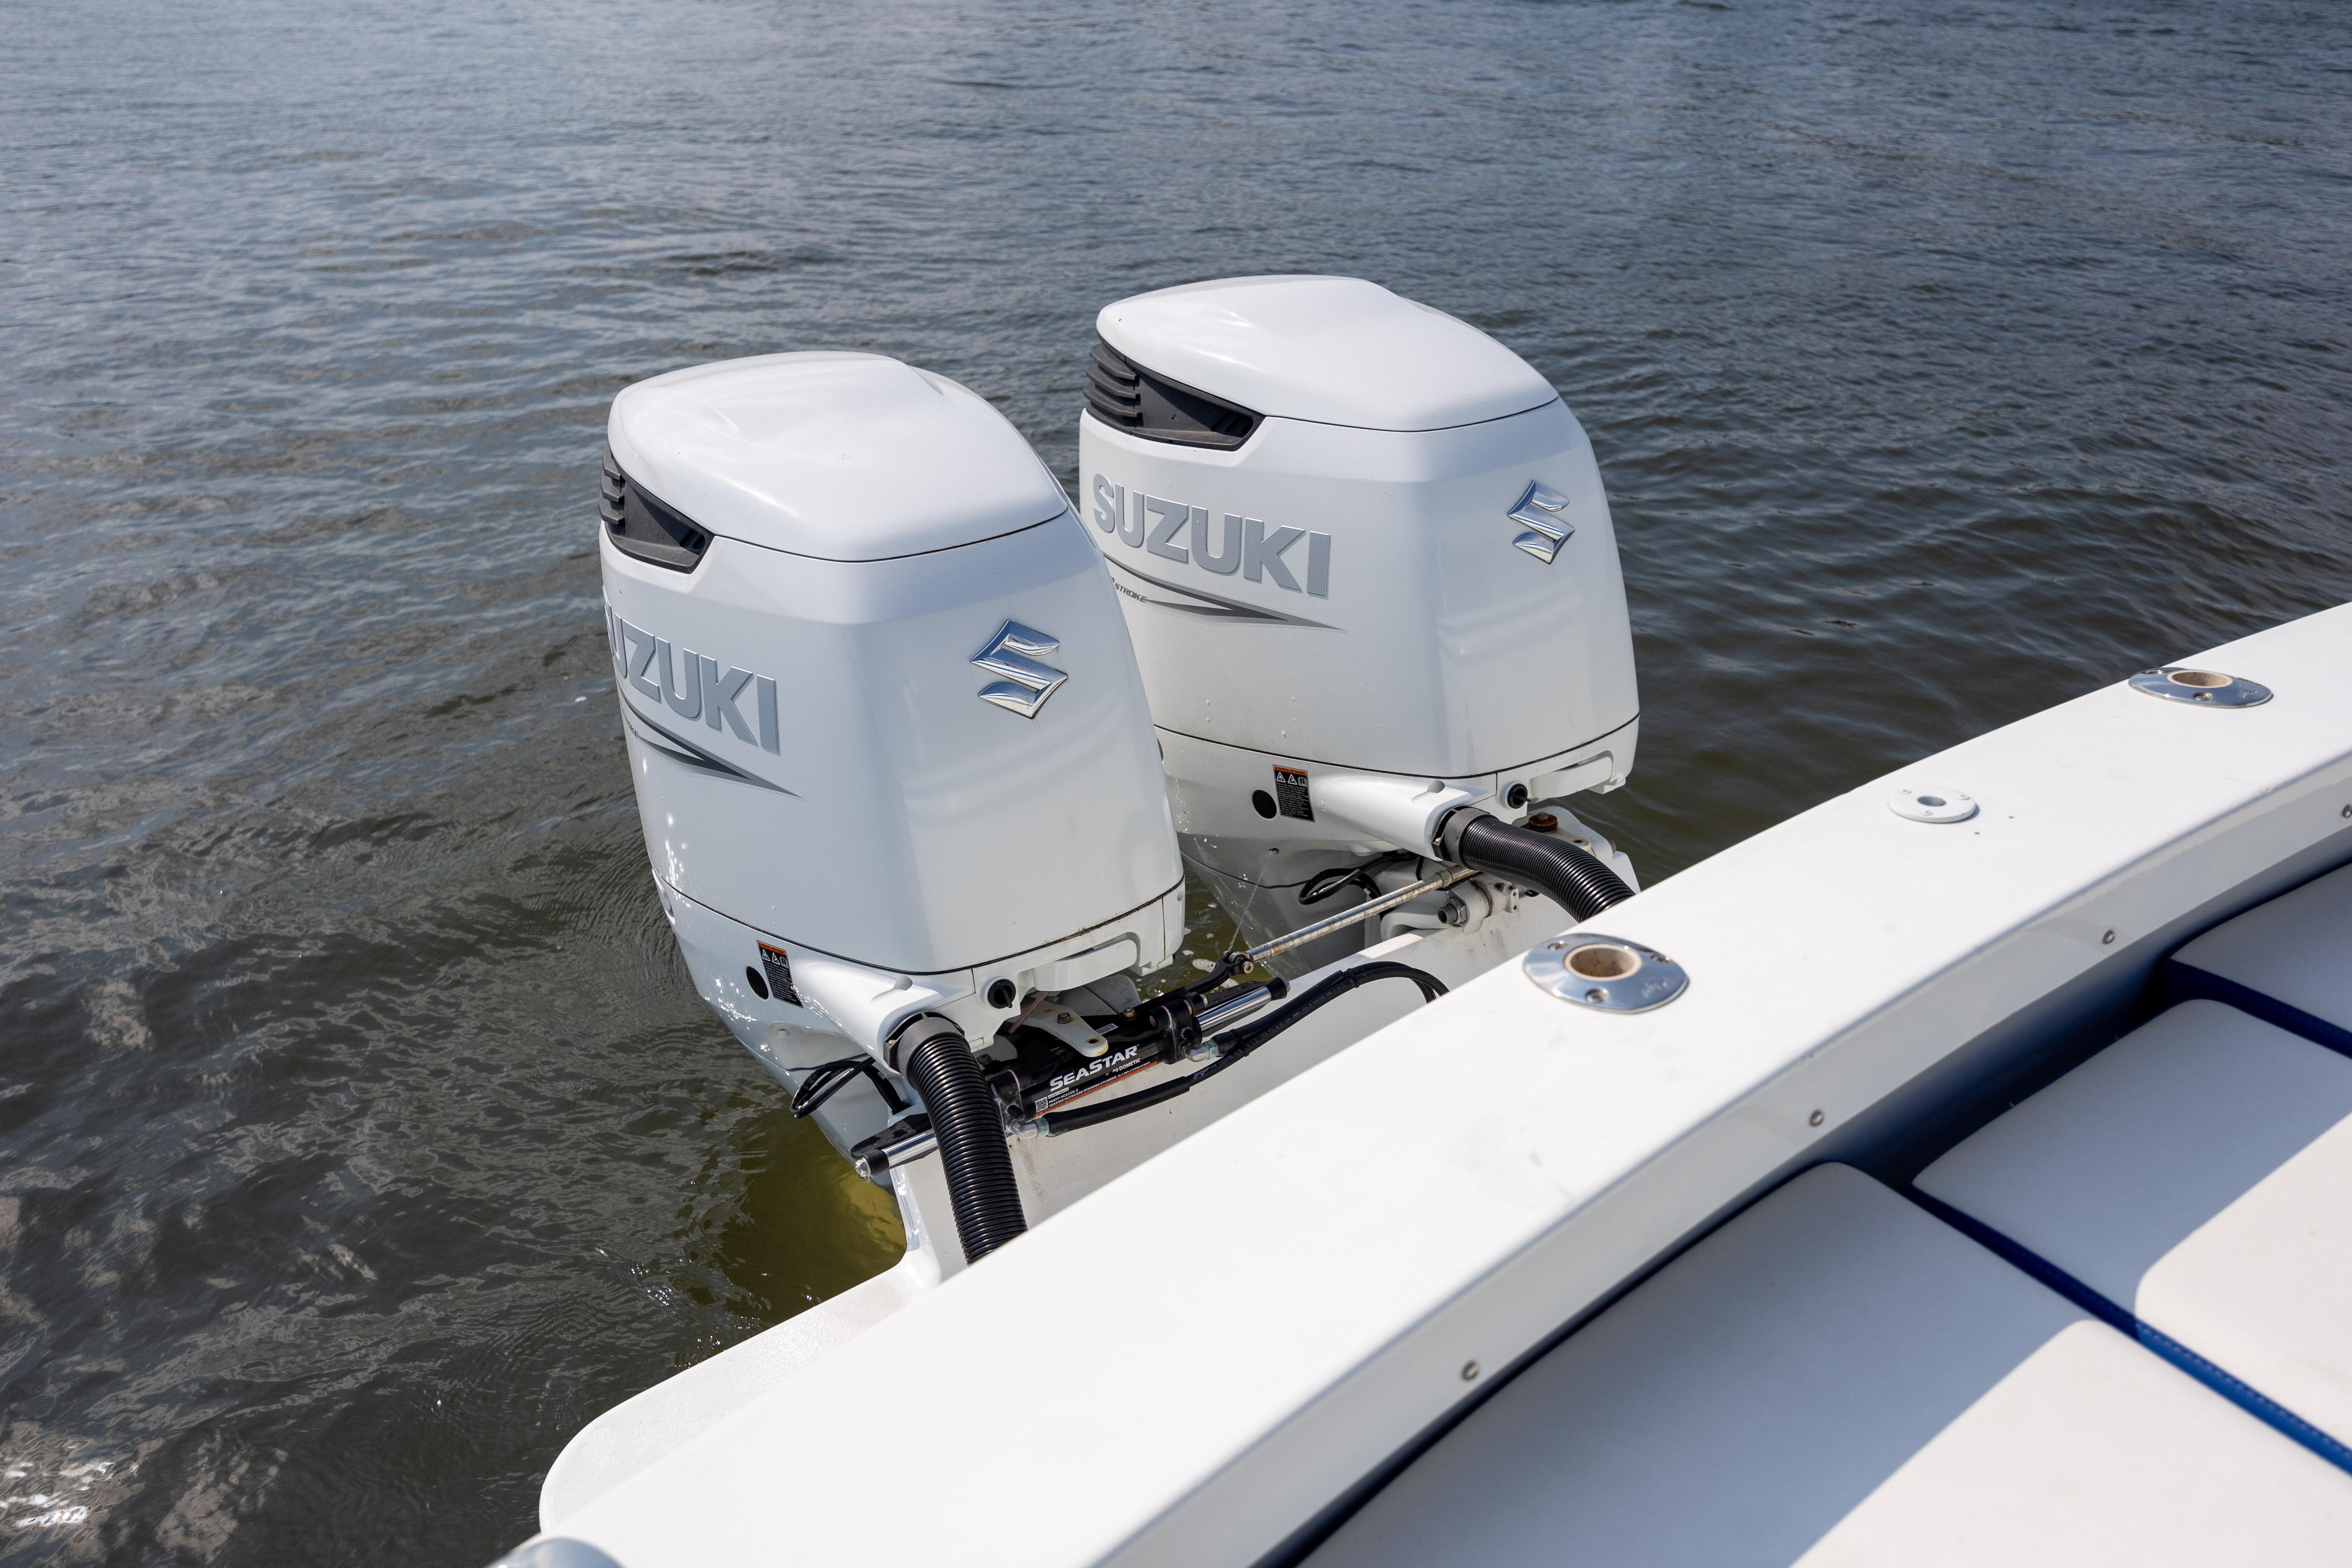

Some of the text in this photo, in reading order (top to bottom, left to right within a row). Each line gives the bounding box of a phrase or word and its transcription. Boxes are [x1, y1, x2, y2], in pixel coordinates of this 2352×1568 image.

[1093, 473, 1331, 599] SUZUKI
[1115, 583, 1148, 603] STROKE
[1050, 1045, 1138, 1092] SEASTAR
[1119, 1058, 1140, 1071] DOMETIC
[1049, 1099, 1064, 1107] SEASTAR
[1064, 1090, 1083, 1100] OUTBOARD
[1084, 1083, 1100, 1093] STEERING
[1100, 1076, 1117, 1085] CYLINDER
